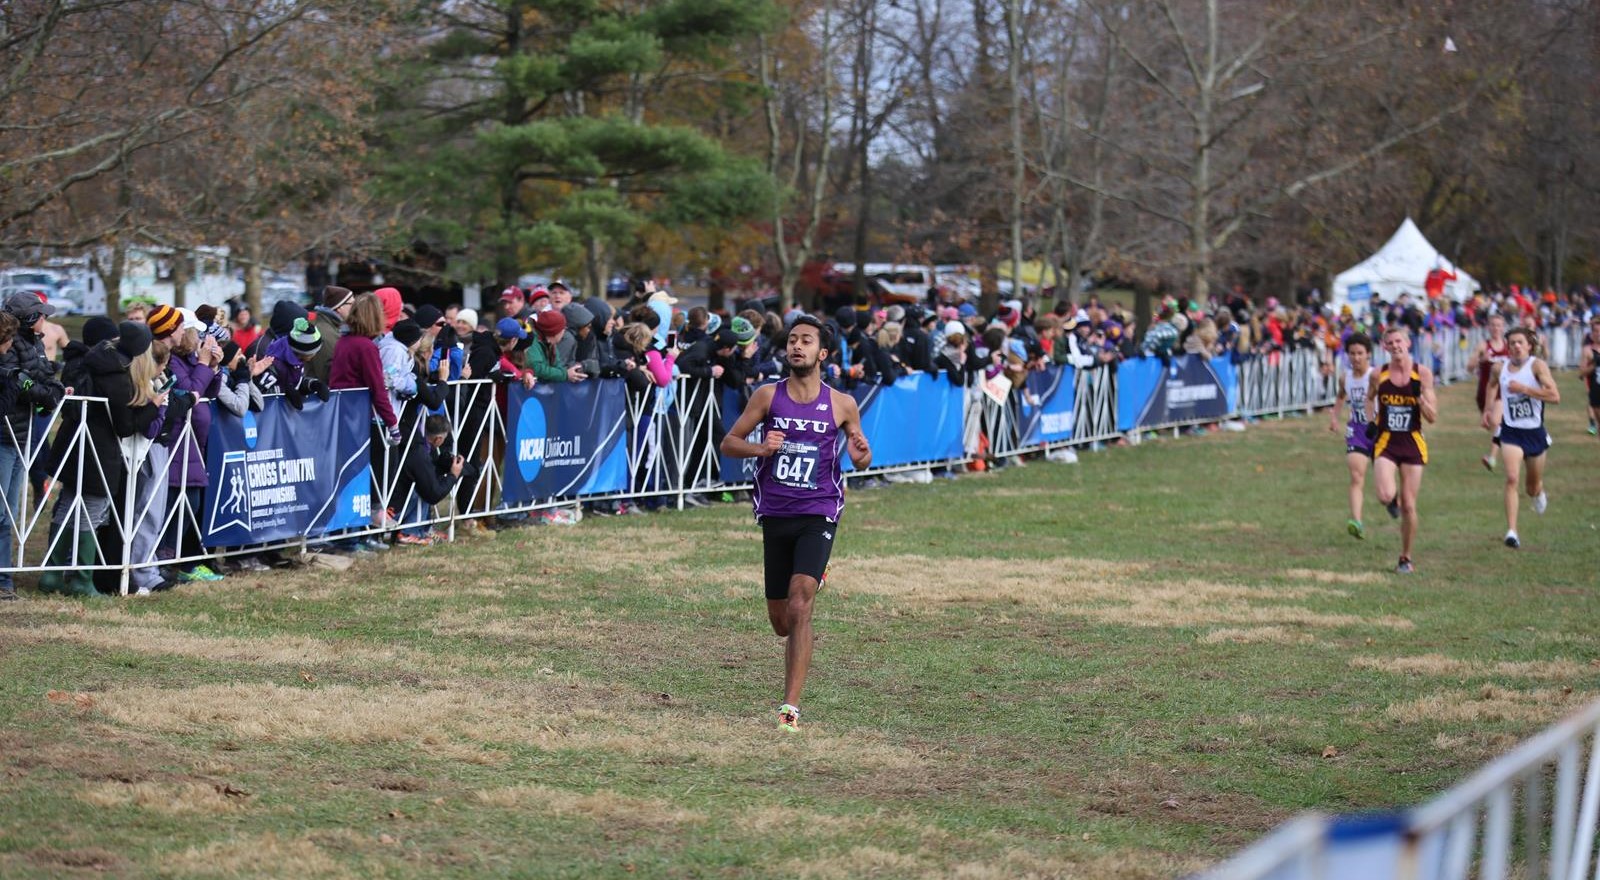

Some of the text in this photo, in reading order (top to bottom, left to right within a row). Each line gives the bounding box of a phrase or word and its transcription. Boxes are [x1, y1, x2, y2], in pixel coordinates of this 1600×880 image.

[1510, 401, 1532, 418] 739
[773, 417, 830, 433] NYU
[519, 437, 545, 461] NCAA
[247, 461, 278, 488] CROSS
[776, 455, 815, 482] 647
